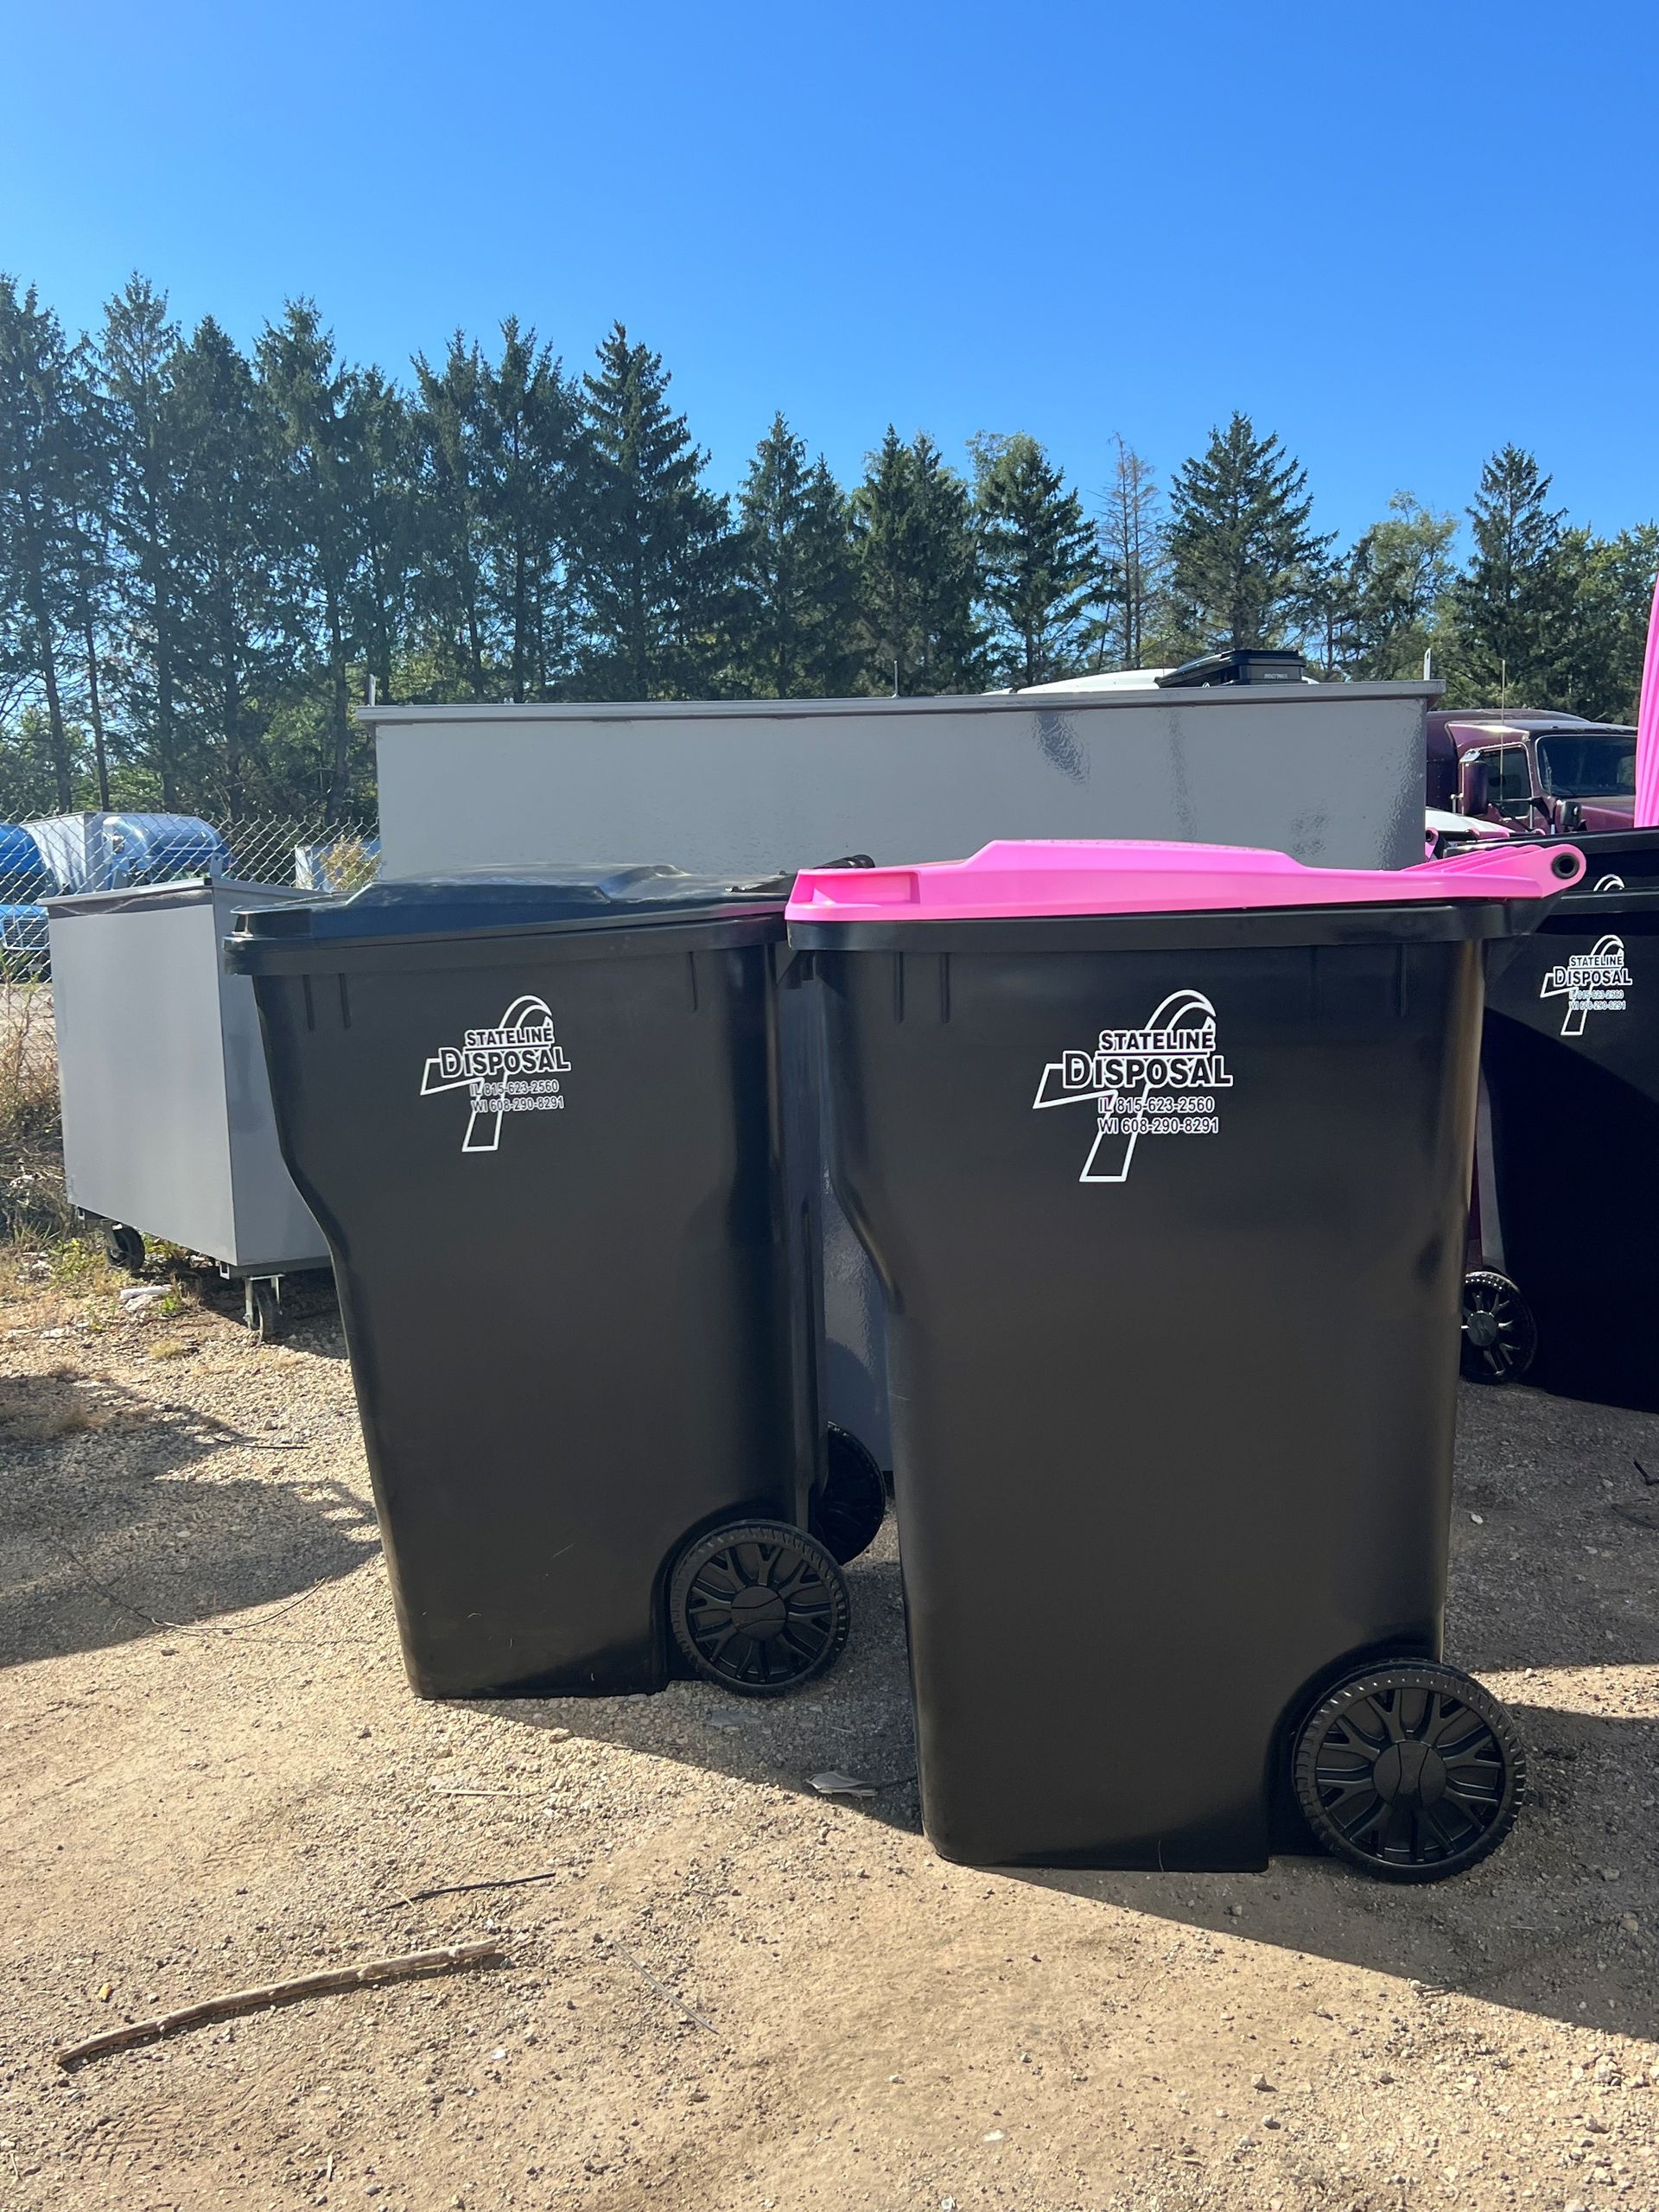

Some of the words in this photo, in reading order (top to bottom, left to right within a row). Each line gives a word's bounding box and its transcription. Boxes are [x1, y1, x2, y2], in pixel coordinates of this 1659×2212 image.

[1569, 955, 1624, 966] STATELINE
[1554, 966, 1632, 987] DISPOSAL
[466, 1027, 554, 1046] STATELINE
[1099, 1030, 1215, 1051] STATELINE
[439, 1047, 571, 1077] DISPOSAL
[1063, 1051, 1233, 1089] DISPOSAL
[470, 1084, 481, 1096] IL
[484, 1079, 559, 1096] 815-623-2560
[471, 1099, 488, 1113] WI
[490, 1096, 564, 1112] 608-290-8291
[1098, 1097, 1113, 1114] IL
[1116, 1096, 1215, 1114] 815-623-2560
[1097, 1118, 1118, 1134] WI
[1121, 1117, 1219, 1134] 608-290-8291
